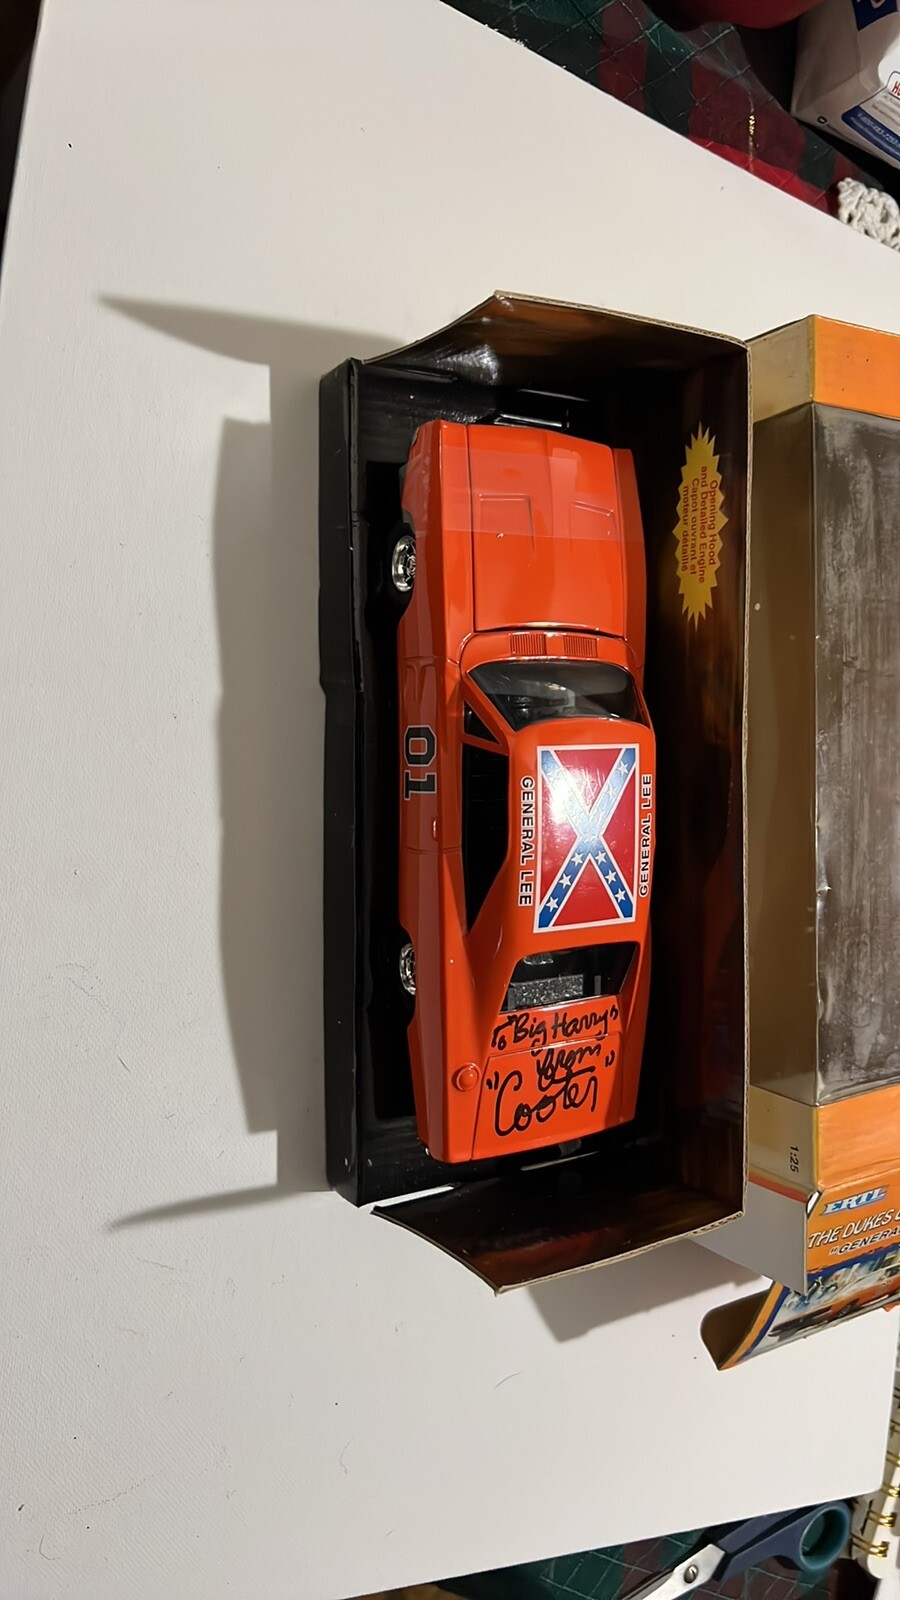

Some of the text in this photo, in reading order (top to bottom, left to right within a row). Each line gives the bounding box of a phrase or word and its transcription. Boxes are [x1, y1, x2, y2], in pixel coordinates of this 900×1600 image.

[690, 478, 699, 575] Capot ouvrant et
[699, 491, 708, 539] Detailed
[707, 480, 718, 566] Opening Hood
[681, 530, 689, 572] détaillé
[698, 542, 708, 584] Engine
[403, 725, 437, 801] 01
[518, 775, 535, 906] GENERAL LEE
[639, 774, 652, 898] GENERAL LEE
[789, 1146, 799, 1173] 1:25
[823, 1186, 888, 1215] ERTL
[808, 1225, 843, 1249] THE
[842, 1208, 895, 1240] DUKES
[829, 1227, 900, 1256] "GENERA
